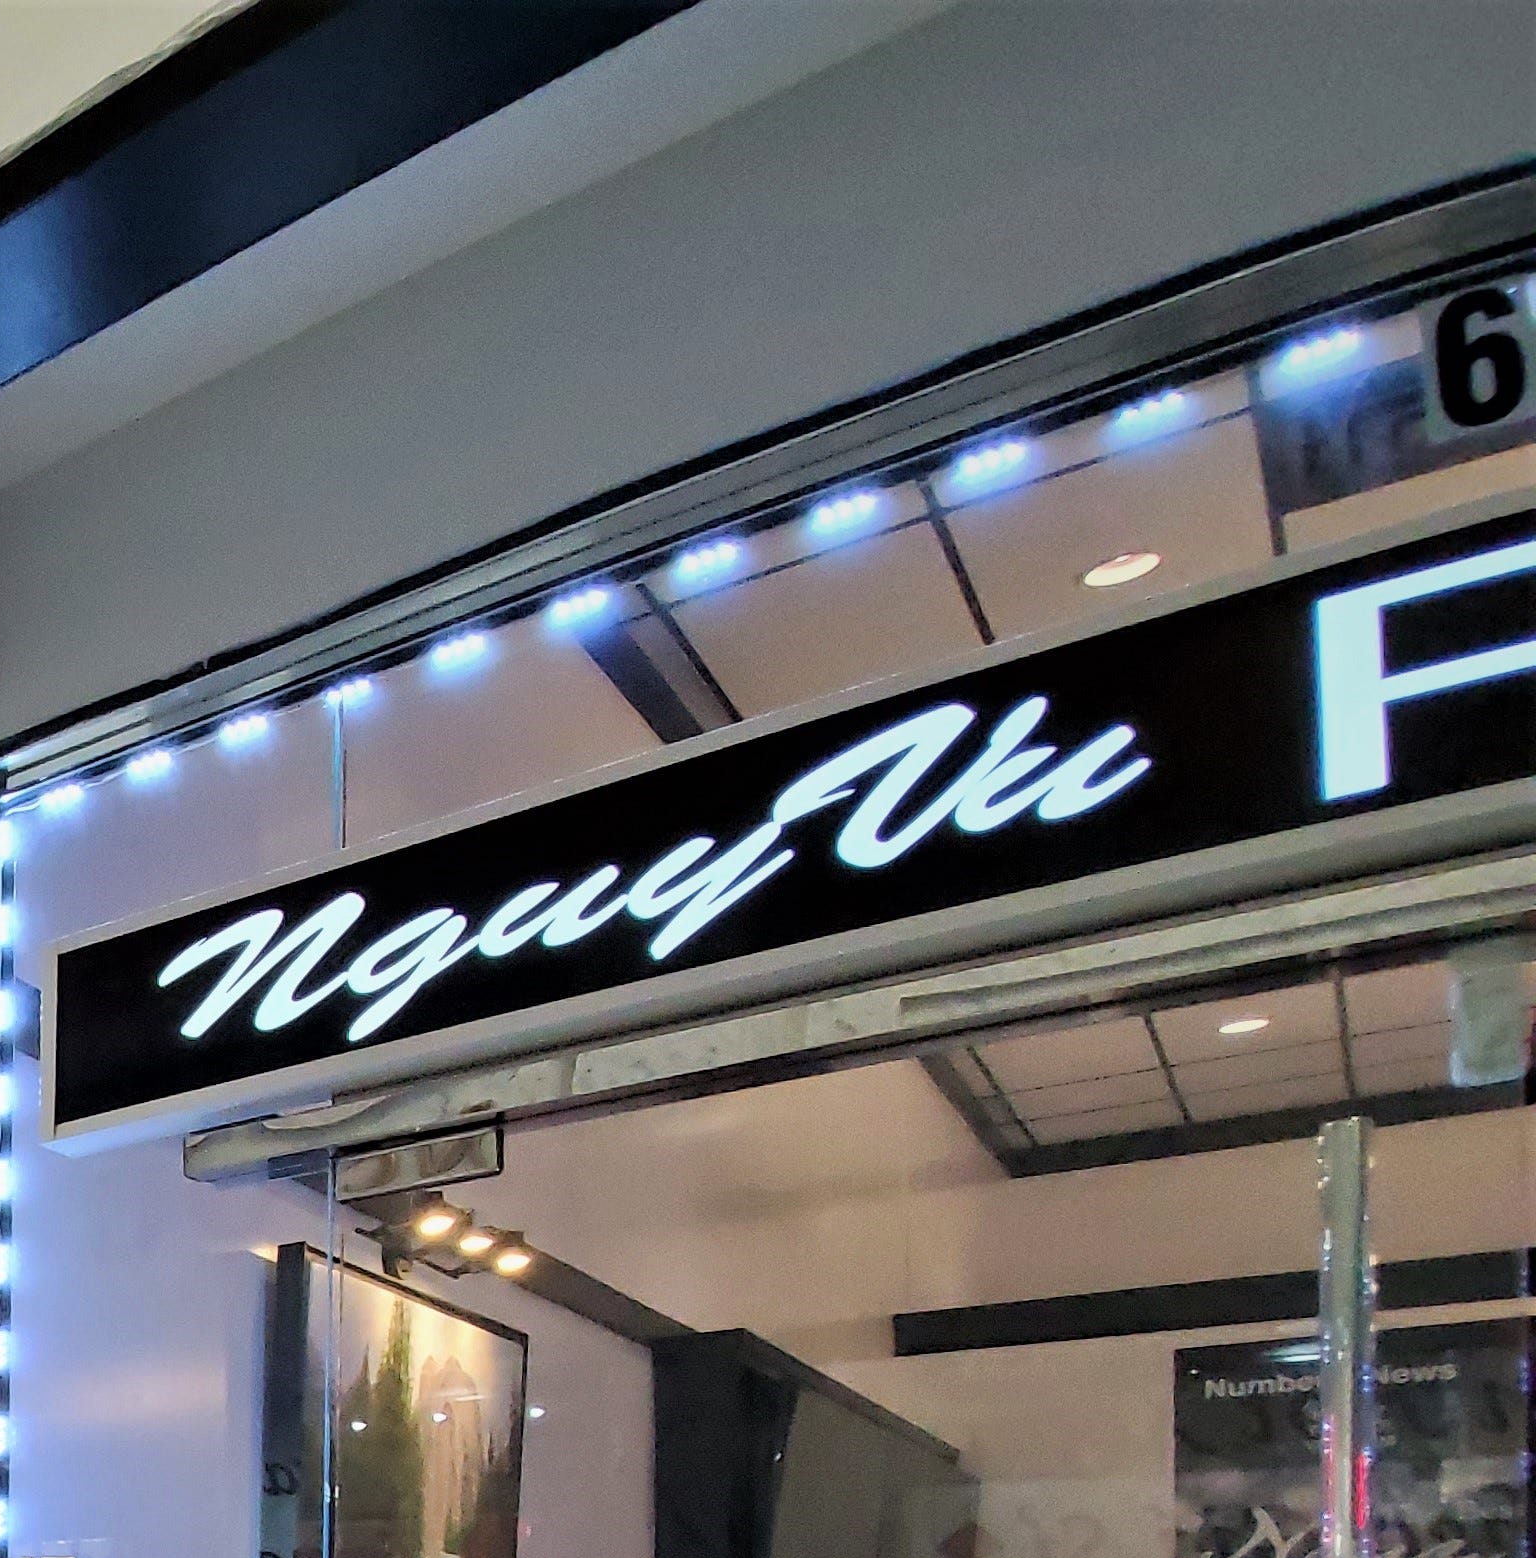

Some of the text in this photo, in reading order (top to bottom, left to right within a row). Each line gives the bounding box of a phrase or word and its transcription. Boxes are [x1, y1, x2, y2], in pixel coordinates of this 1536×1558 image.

[1436, 288, 1526, 427] 6
[157, 820, 795, 1043] Nguy
[773, 696, 1153, 869] Vu
